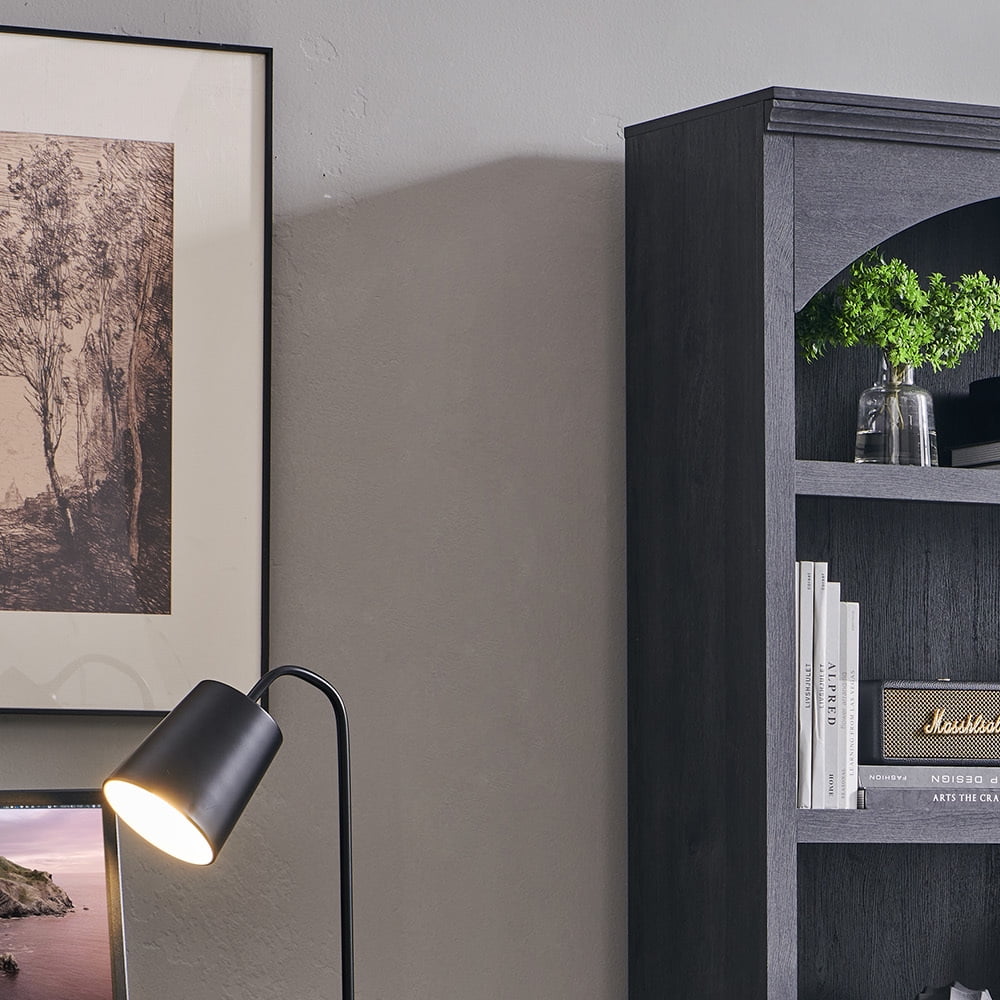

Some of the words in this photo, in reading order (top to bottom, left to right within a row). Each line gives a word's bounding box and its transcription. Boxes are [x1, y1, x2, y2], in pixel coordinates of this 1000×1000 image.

[827, 662, 836, 727] ALPRED
[932, 775, 983, 784] DESIGN
[933, 794, 956, 802] ARTS
[959, 794, 977, 802] THE
